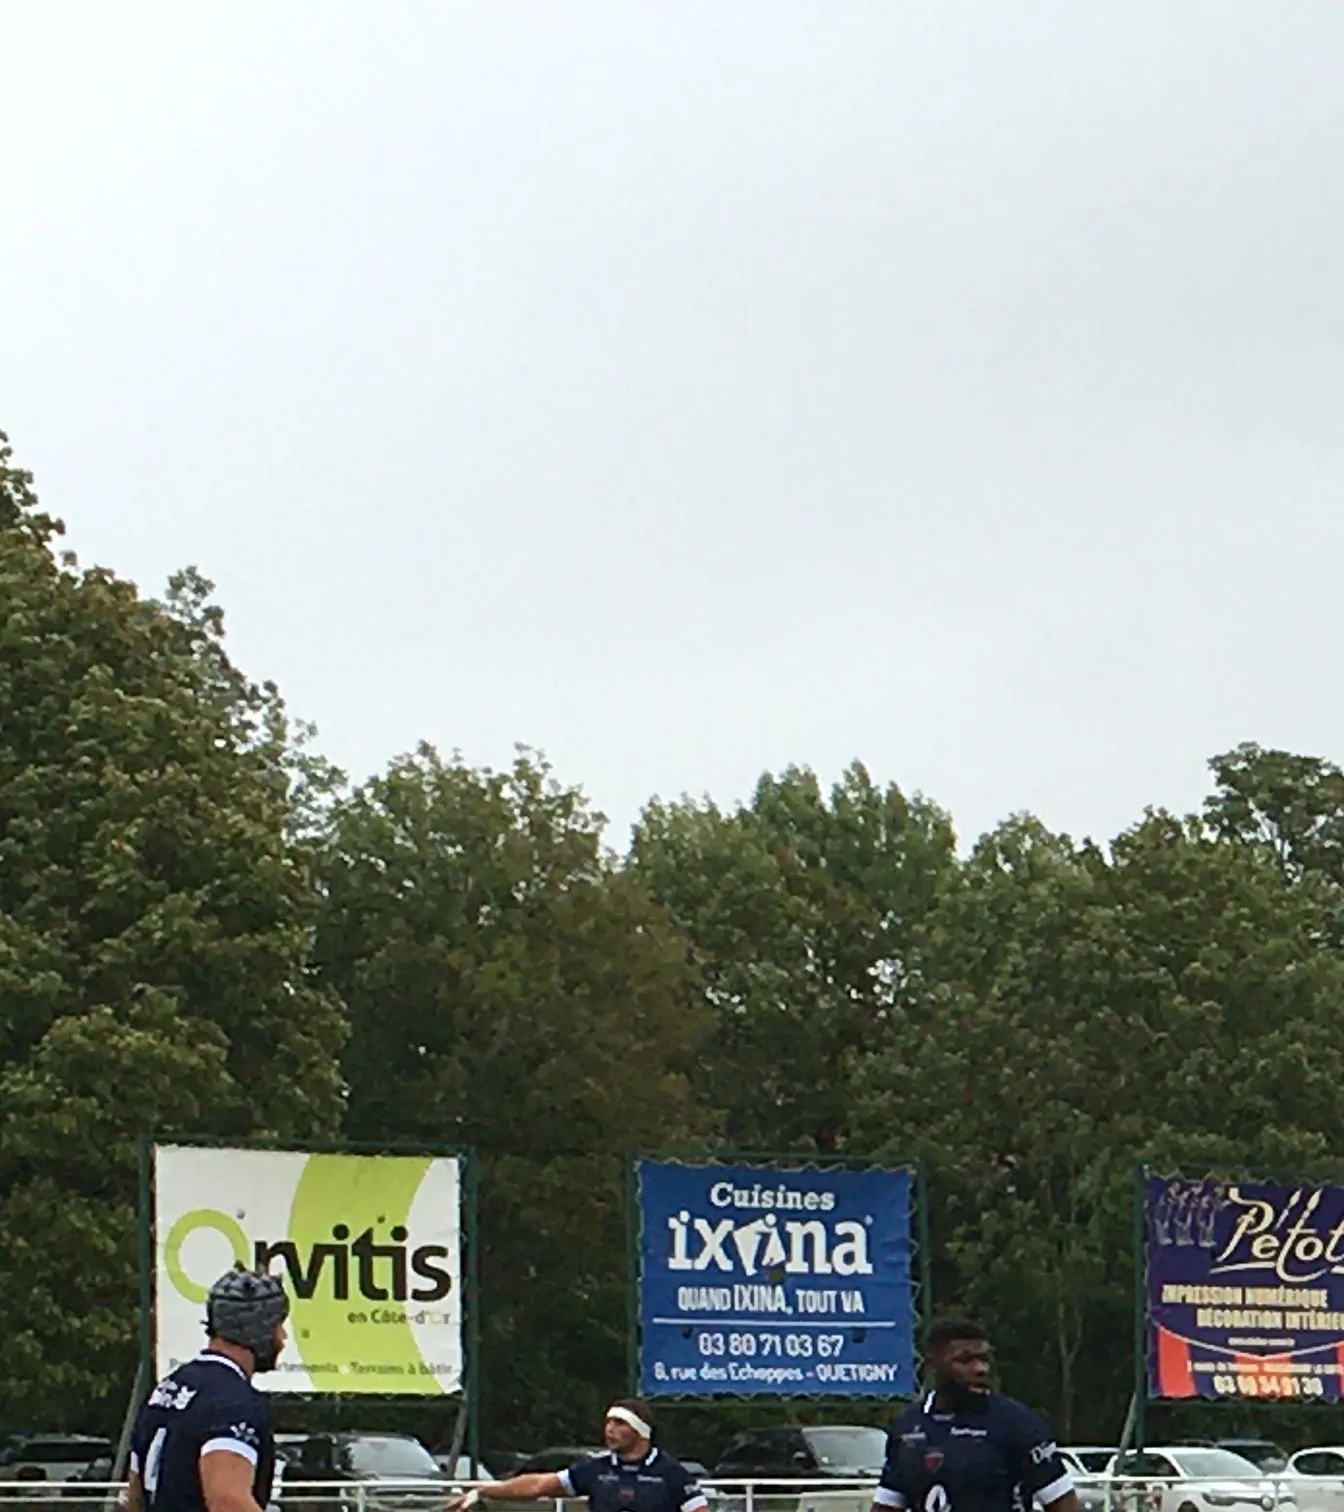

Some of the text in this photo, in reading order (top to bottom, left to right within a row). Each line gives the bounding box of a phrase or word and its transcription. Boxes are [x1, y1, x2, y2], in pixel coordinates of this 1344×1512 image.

[711, 1182, 836, 1211] Cuisines
[163, 1208, 453, 1303] Orvitis
[668, 1210, 874, 1276] ixina
[678, 1287, 731, 1311] QUAND
[796, 1290, 837, 1313] TOUT
[841, 1291, 865, 1313] VA
[699, 1333, 845, 1357] 03 80 71 03 67
[670, 1367, 697, 1381] rue
[700, 1362, 728, 1381] des
[816, 1364, 898, 1382] QUETIGNY
